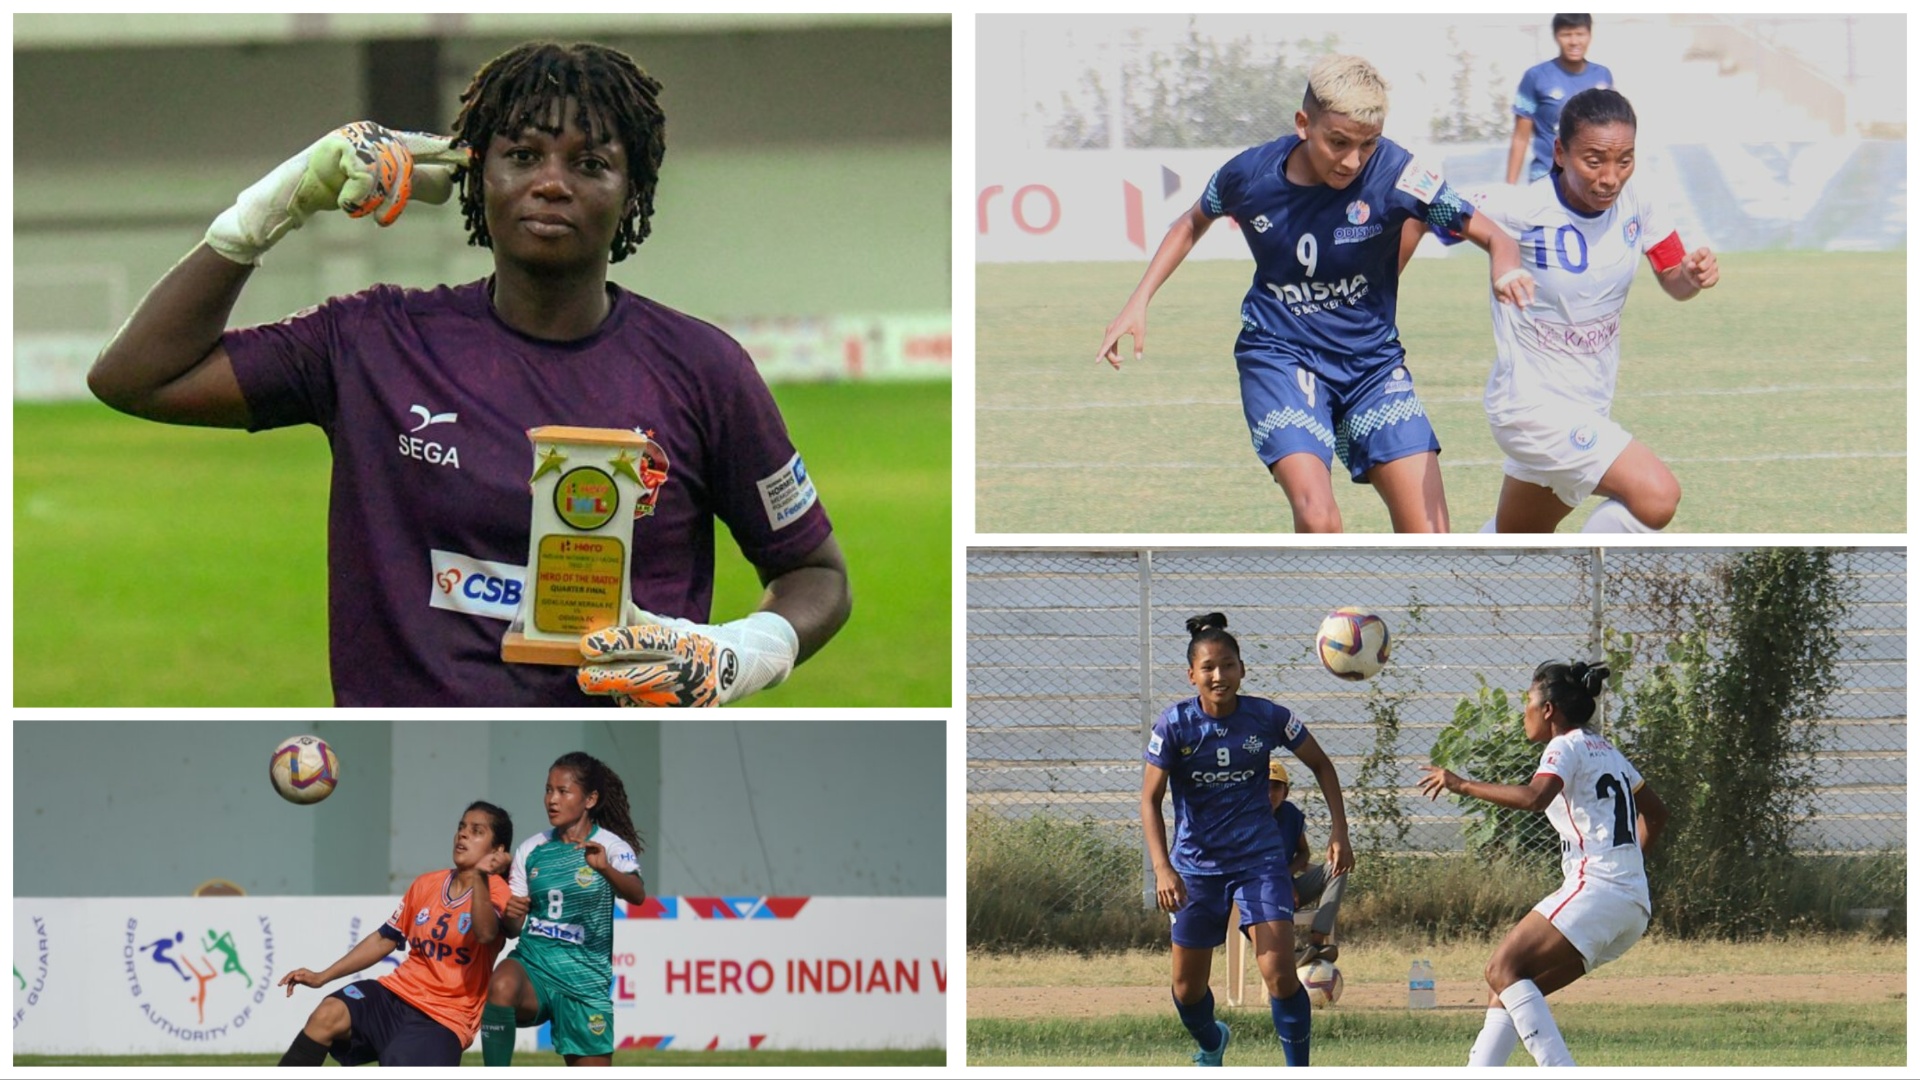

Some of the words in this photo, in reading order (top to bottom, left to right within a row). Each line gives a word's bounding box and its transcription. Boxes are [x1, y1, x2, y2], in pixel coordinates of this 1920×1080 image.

[1333, 223, 1384, 239] ODISHA
[1296, 233, 1318, 278] 9
[1520, 224, 1589, 274] 10
[398, 433, 460, 469] SEGA
[574, 542, 603, 552] Hero
[462, 573, 522, 606] CSB
[540, 572, 562, 582] HERO
[562, 573, 574, 582] OF
[1216, 747, 1231, 767] 9
[547, 889, 564, 919] 8
[431, 912, 452, 941] 5
[27, 915, 50, 1006] GUJARAT
[665, 959, 774, 995] HERO
[786, 959, 920, 995] INDIAN
[124, 917, 143, 998] SPORTS
[140, 1002, 229, 1042] AUTHORITY
[233, 1006, 252, 1029] OF
[253, 914, 275, 1005] GUJARAT
